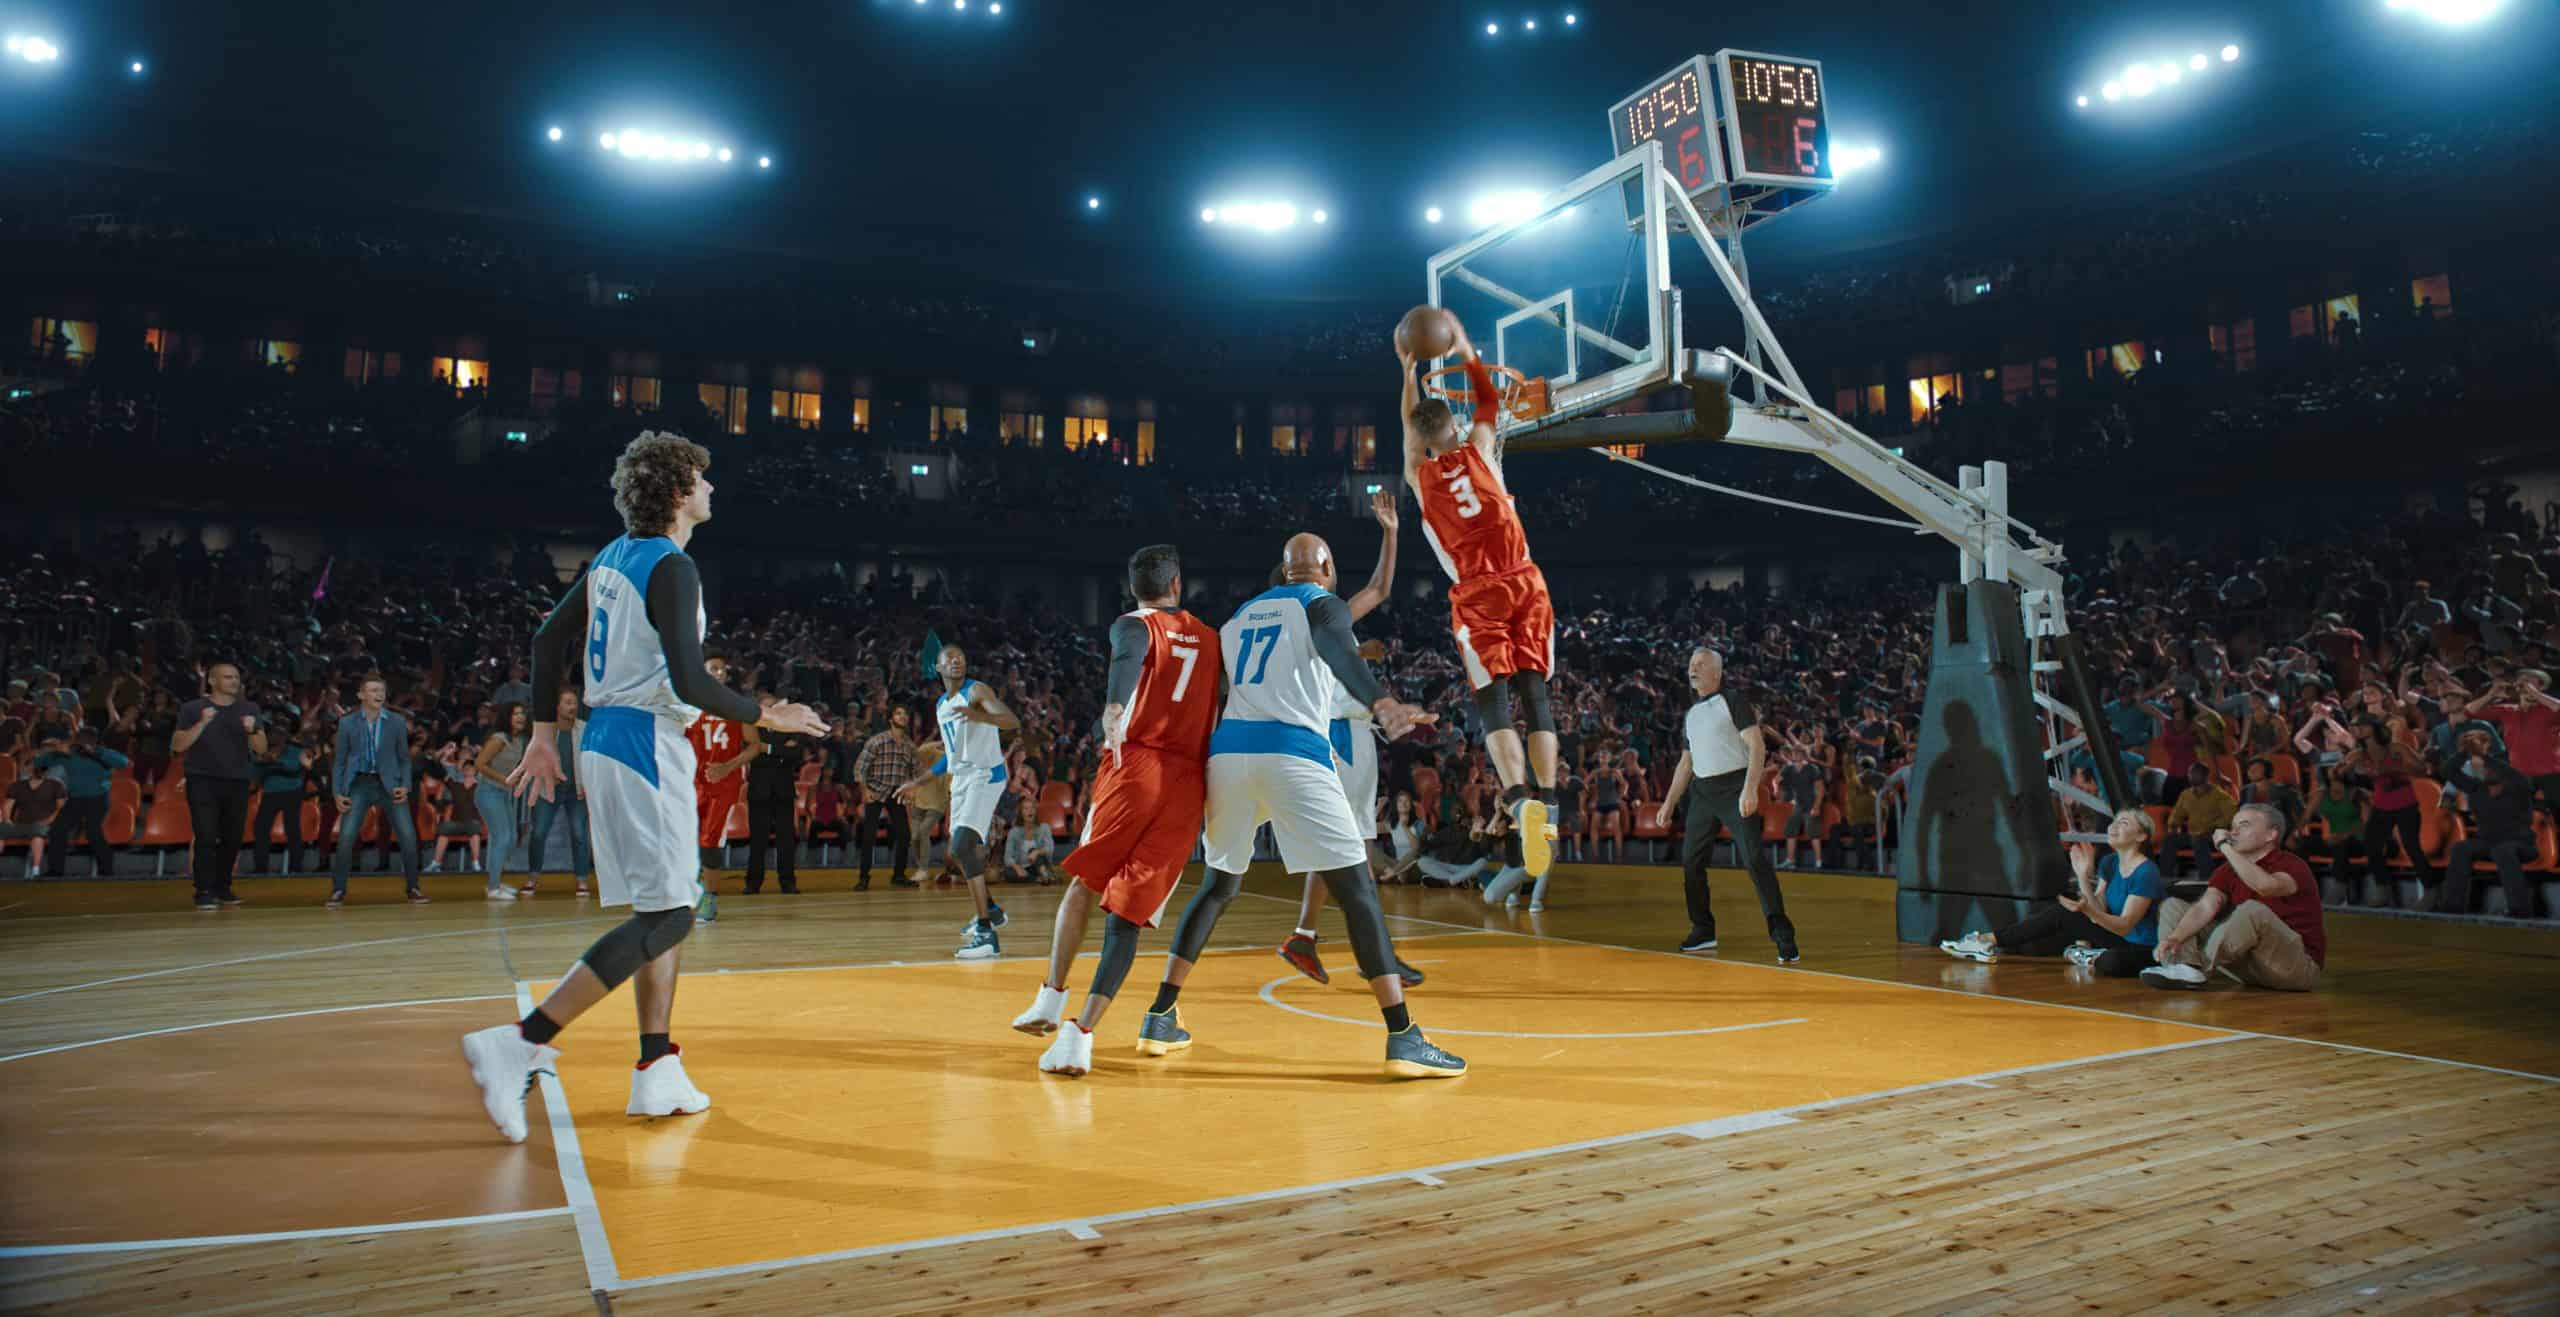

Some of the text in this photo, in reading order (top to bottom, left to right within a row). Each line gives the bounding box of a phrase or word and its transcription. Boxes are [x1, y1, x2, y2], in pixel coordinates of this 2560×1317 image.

[1677, 125, 1705, 189] 6
[1793, 118, 1819, 174] 6
[1449, 475, 1482, 518] 3
[589, 607, 609, 683] 8
[1171, 645, 1199, 702] 7
[1233, 624, 1282, 685] 17
[701, 722, 731, 751] 14
